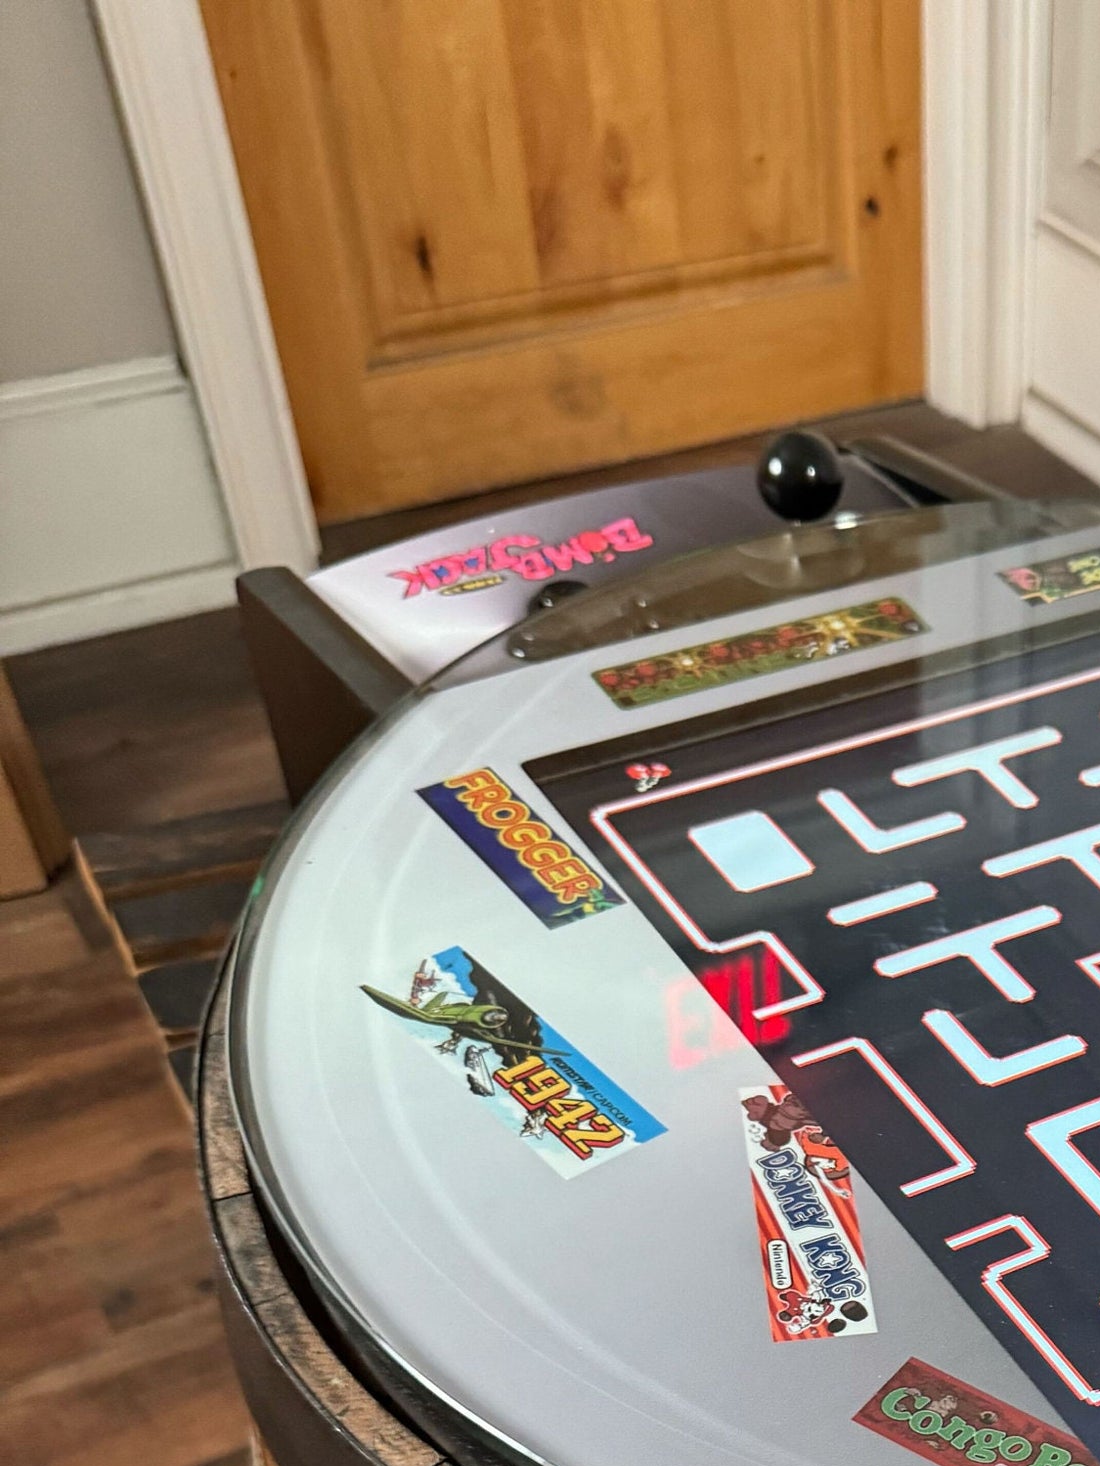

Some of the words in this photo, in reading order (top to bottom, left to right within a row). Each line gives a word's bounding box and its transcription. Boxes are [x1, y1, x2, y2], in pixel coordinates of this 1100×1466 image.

[391, 534, 542, 600] JACK
[520, 517, 653, 581] BOMB
[443, 768, 604, 905] FROGGER
[493, 1055, 626, 1161] 1942
[756, 1147, 834, 1230] DONKEY
[800, 1233, 866, 1301] KONG
[771, 1243, 788, 1287] Nintendo
[880, 1386, 1033, 1463] Congo
